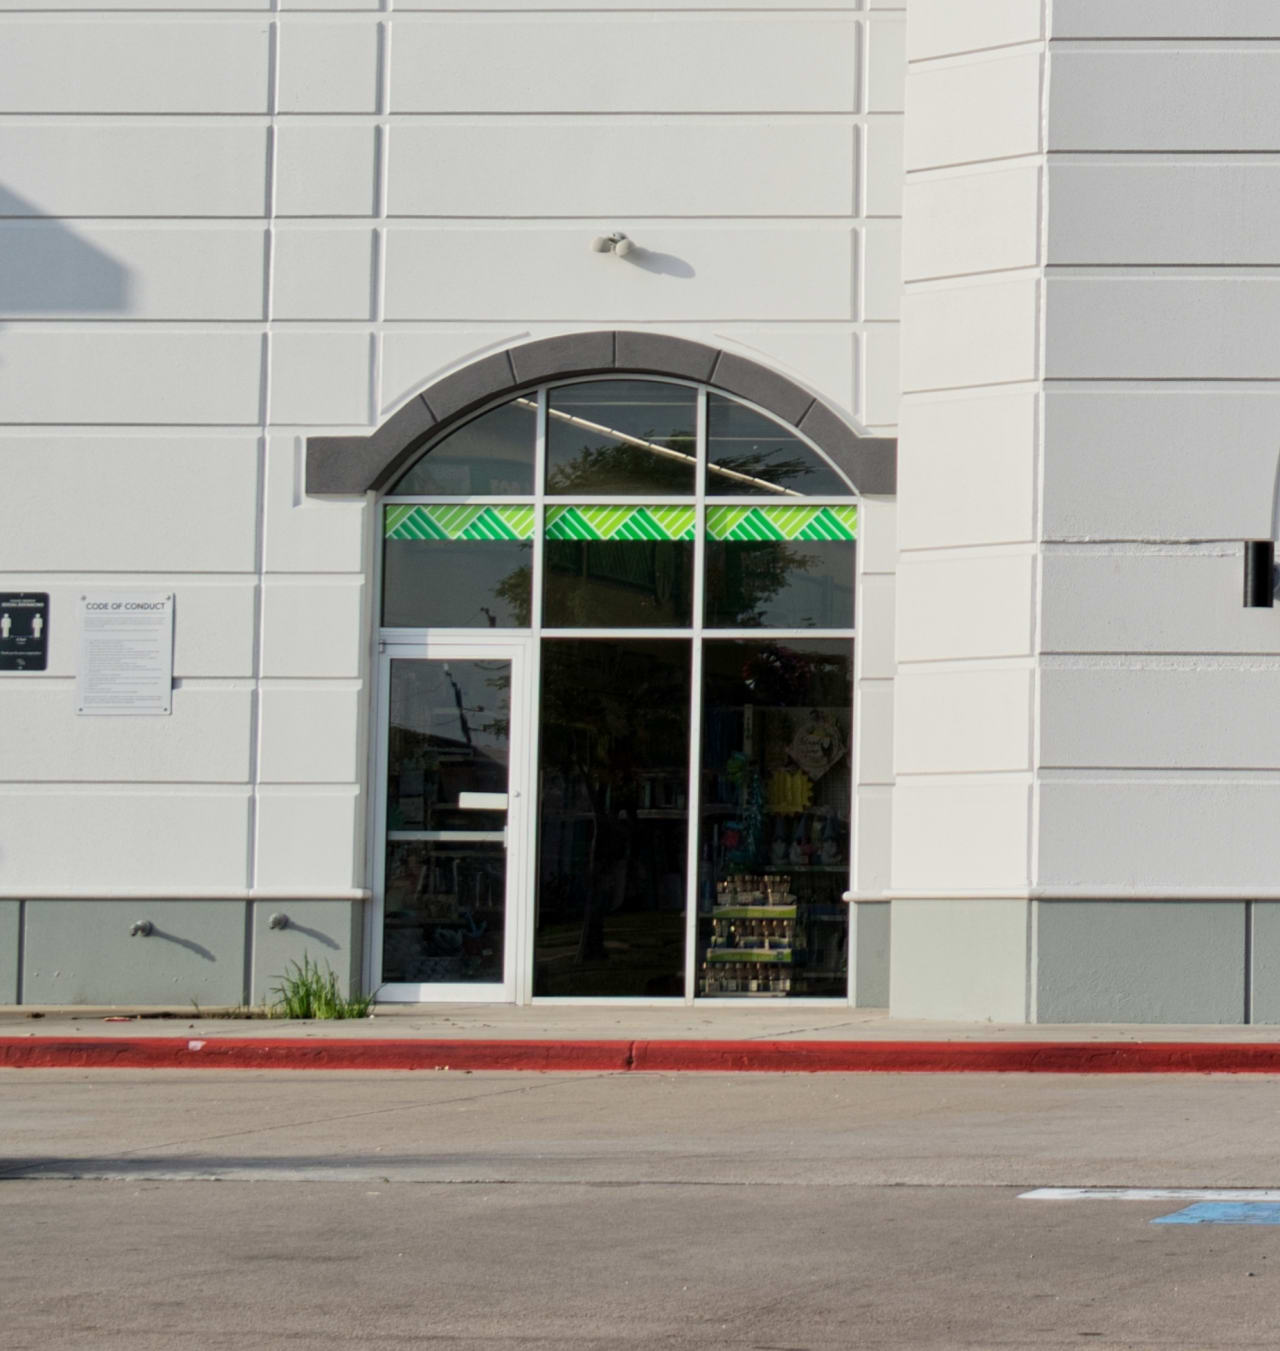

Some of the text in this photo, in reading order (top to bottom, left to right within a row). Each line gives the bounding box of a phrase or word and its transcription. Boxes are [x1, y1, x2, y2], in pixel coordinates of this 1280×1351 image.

[86, 602, 165, 610] CODE OF CONDUCT
